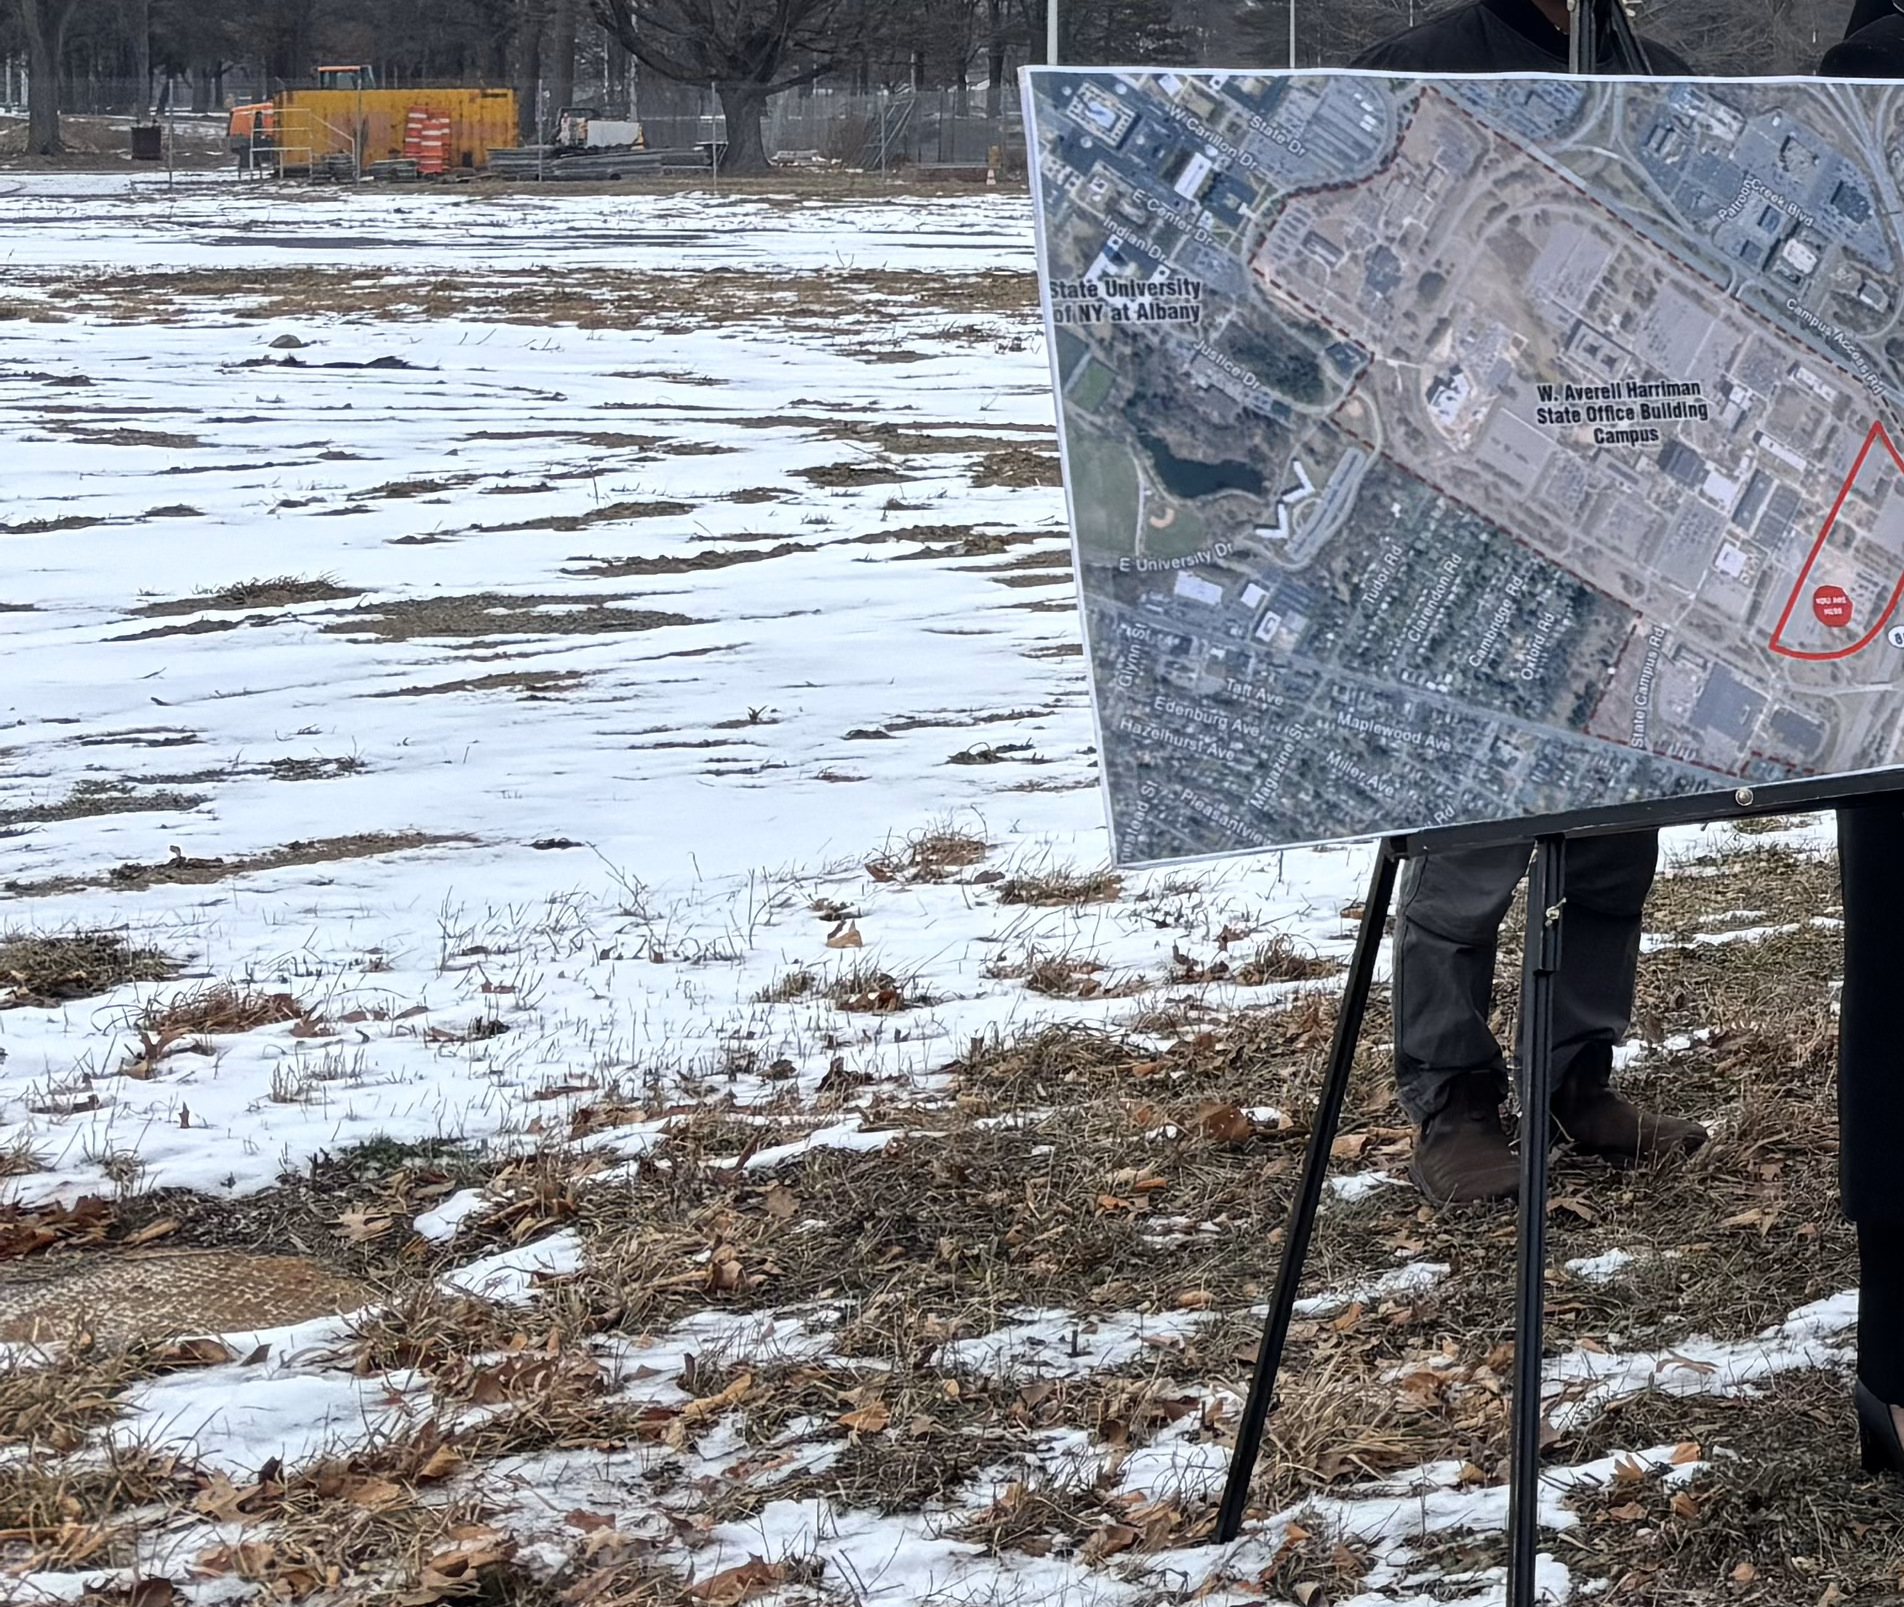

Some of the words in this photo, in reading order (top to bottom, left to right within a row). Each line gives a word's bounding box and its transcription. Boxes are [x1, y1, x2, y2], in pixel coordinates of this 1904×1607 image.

[1168, 105, 1184, 123] W
[1186, 117, 1237, 159] Carillon
[1239, 151, 1257, 170] Dr
[1250, 115, 1290, 145] State
[1289, 137, 1306, 155] Dr
[1132, 189, 1145, 203] E
[1146, 197, 1194, 234] Center
[1194, 228, 1214, 245] Dr
[1787, 201, 1815, 227] Blvd
[1104, 215, 1148, 249] Indian
[1148, 243, 1167, 261] Dr
[1050, 279, 1098, 299] State
[1105, 278, 1201, 300] University
[1054, 305, 1072, 323] of
[1078, 304, 1103, 322] NY
[1111, 304, 1130, 322] at
[1136, 302, 1201, 325] Albany
[1193, 341, 1241, 379] Justice
[1242, 370, 1261, 389] Dr
[1786, 298, 1834, 337] Campus
[1833, 329, 1868, 377] Access
[1866, 373, 1884, 395] Rd
[1537, 385, 1559, 402] W.
[1565, 383, 1621, 401] Averell
[1627, 381, 1701, 398] Harriman
[1537, 407, 1581, 425] State
[1586, 404, 1635, 422] Office
[1641, 401, 1709, 421] Building
[1594, 428, 1659, 447] Campus
[1120, 557, 1131, 572] E
[1136, 551, 1211, 572] University
[1214, 542, 1234, 557] Dr
[1361, 572, 1389, 604] Tudor
[1384, 545, 1403, 570] Rd
[1407, 578, 1450, 642] Clarendon
[1444, 553, 1463, 575] Rd
[1468, 598, 1512, 667] Cambridge
[1505, 575, 1524, 597] Rd
[1648, 627, 1665, 647] Rd
[1118, 643, 1142, 687] Glynn
[1520, 634, 1546, 680] Oxford
[1537, 612, 1555, 632] Rd
[1256, 687, 1284, 705] Ave
[1634, 650, 1659, 706] Campus
[1154, 696, 1229, 730] Edenburg
[1231, 718, 1261, 737] Ave
[1337, 711, 1422, 744] Maplewood
[1424, 735, 1451, 752] Ave
[1631, 709, 1646, 748] State
[1120, 717, 1204, 752] Hazelhurst
[1206, 744, 1236, 761] Ave
[1326, 750, 1366, 781] Miller
[1367, 775, 1395, 796] Ave
[1433, 804, 1455, 824] Rd
